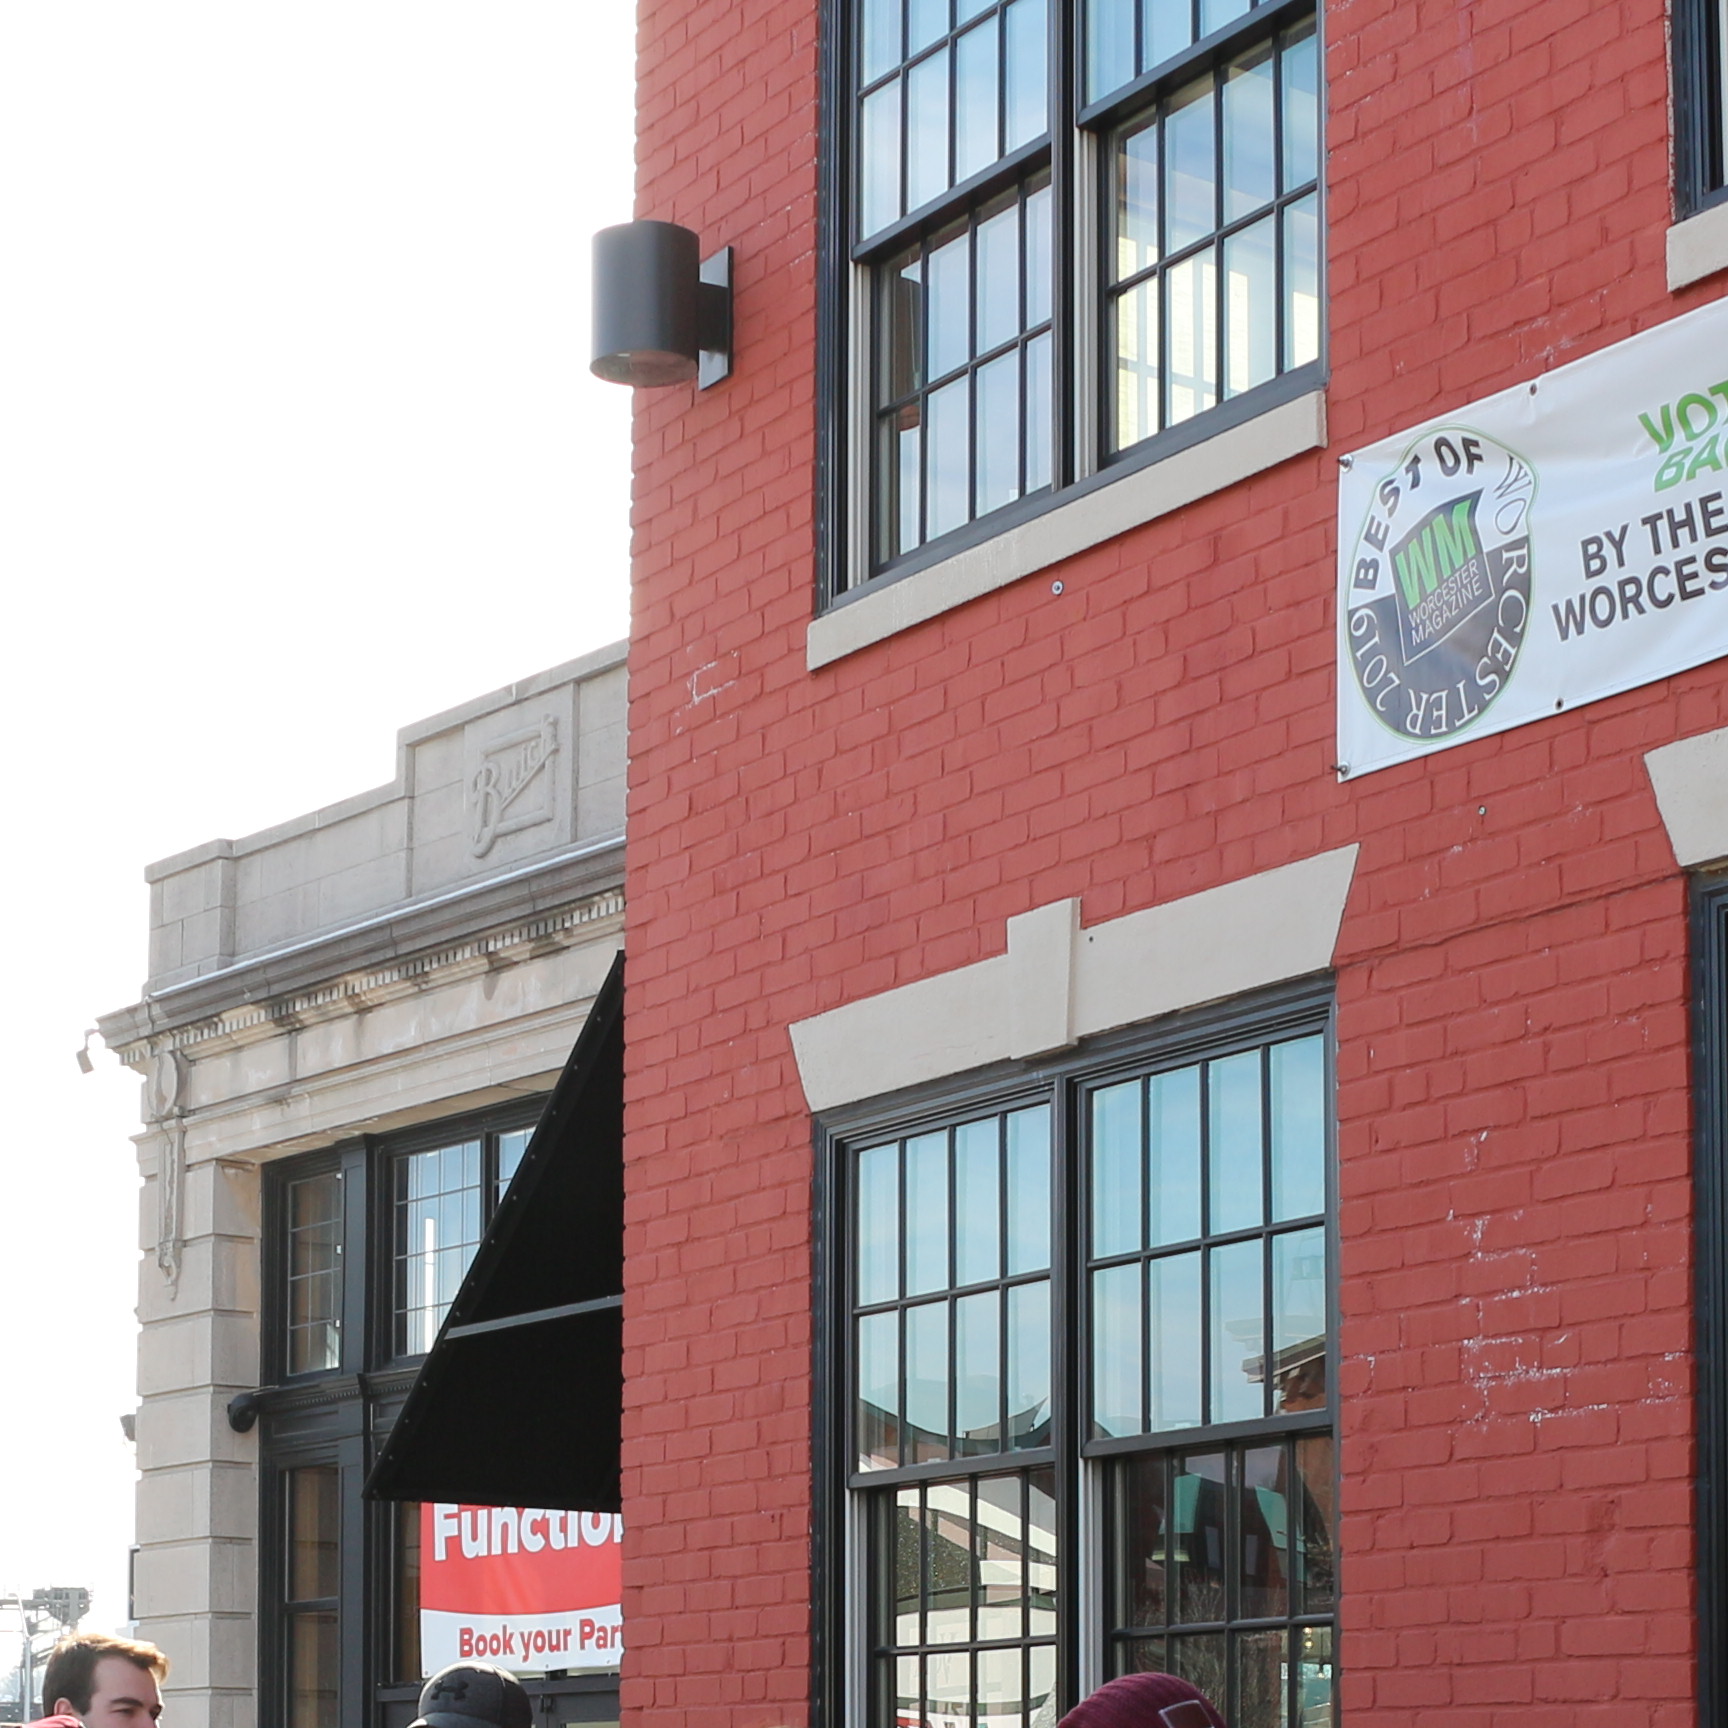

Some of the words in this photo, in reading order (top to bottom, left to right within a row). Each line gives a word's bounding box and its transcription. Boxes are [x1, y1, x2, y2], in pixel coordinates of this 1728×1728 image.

[1353, 454, 1423, 591] BEST
[1434, 436, 1485, 477] OF
[1395, 499, 1477, 611] WM
[1580, 524, 1630, 580] BY
[1642, 491, 1726, 556] THE
[1405, 454, 1533, 736] WORCESTER
[1408, 559, 1479, 628] WORCESTER
[1412, 574, 1483, 646] MAGAZINE
[1351, 607, 1401, 712] 2016
[459, 1624, 515, 1658] Book
[521, 1627, 571, 1662] your
[579, 1618, 621, 1650] Par
